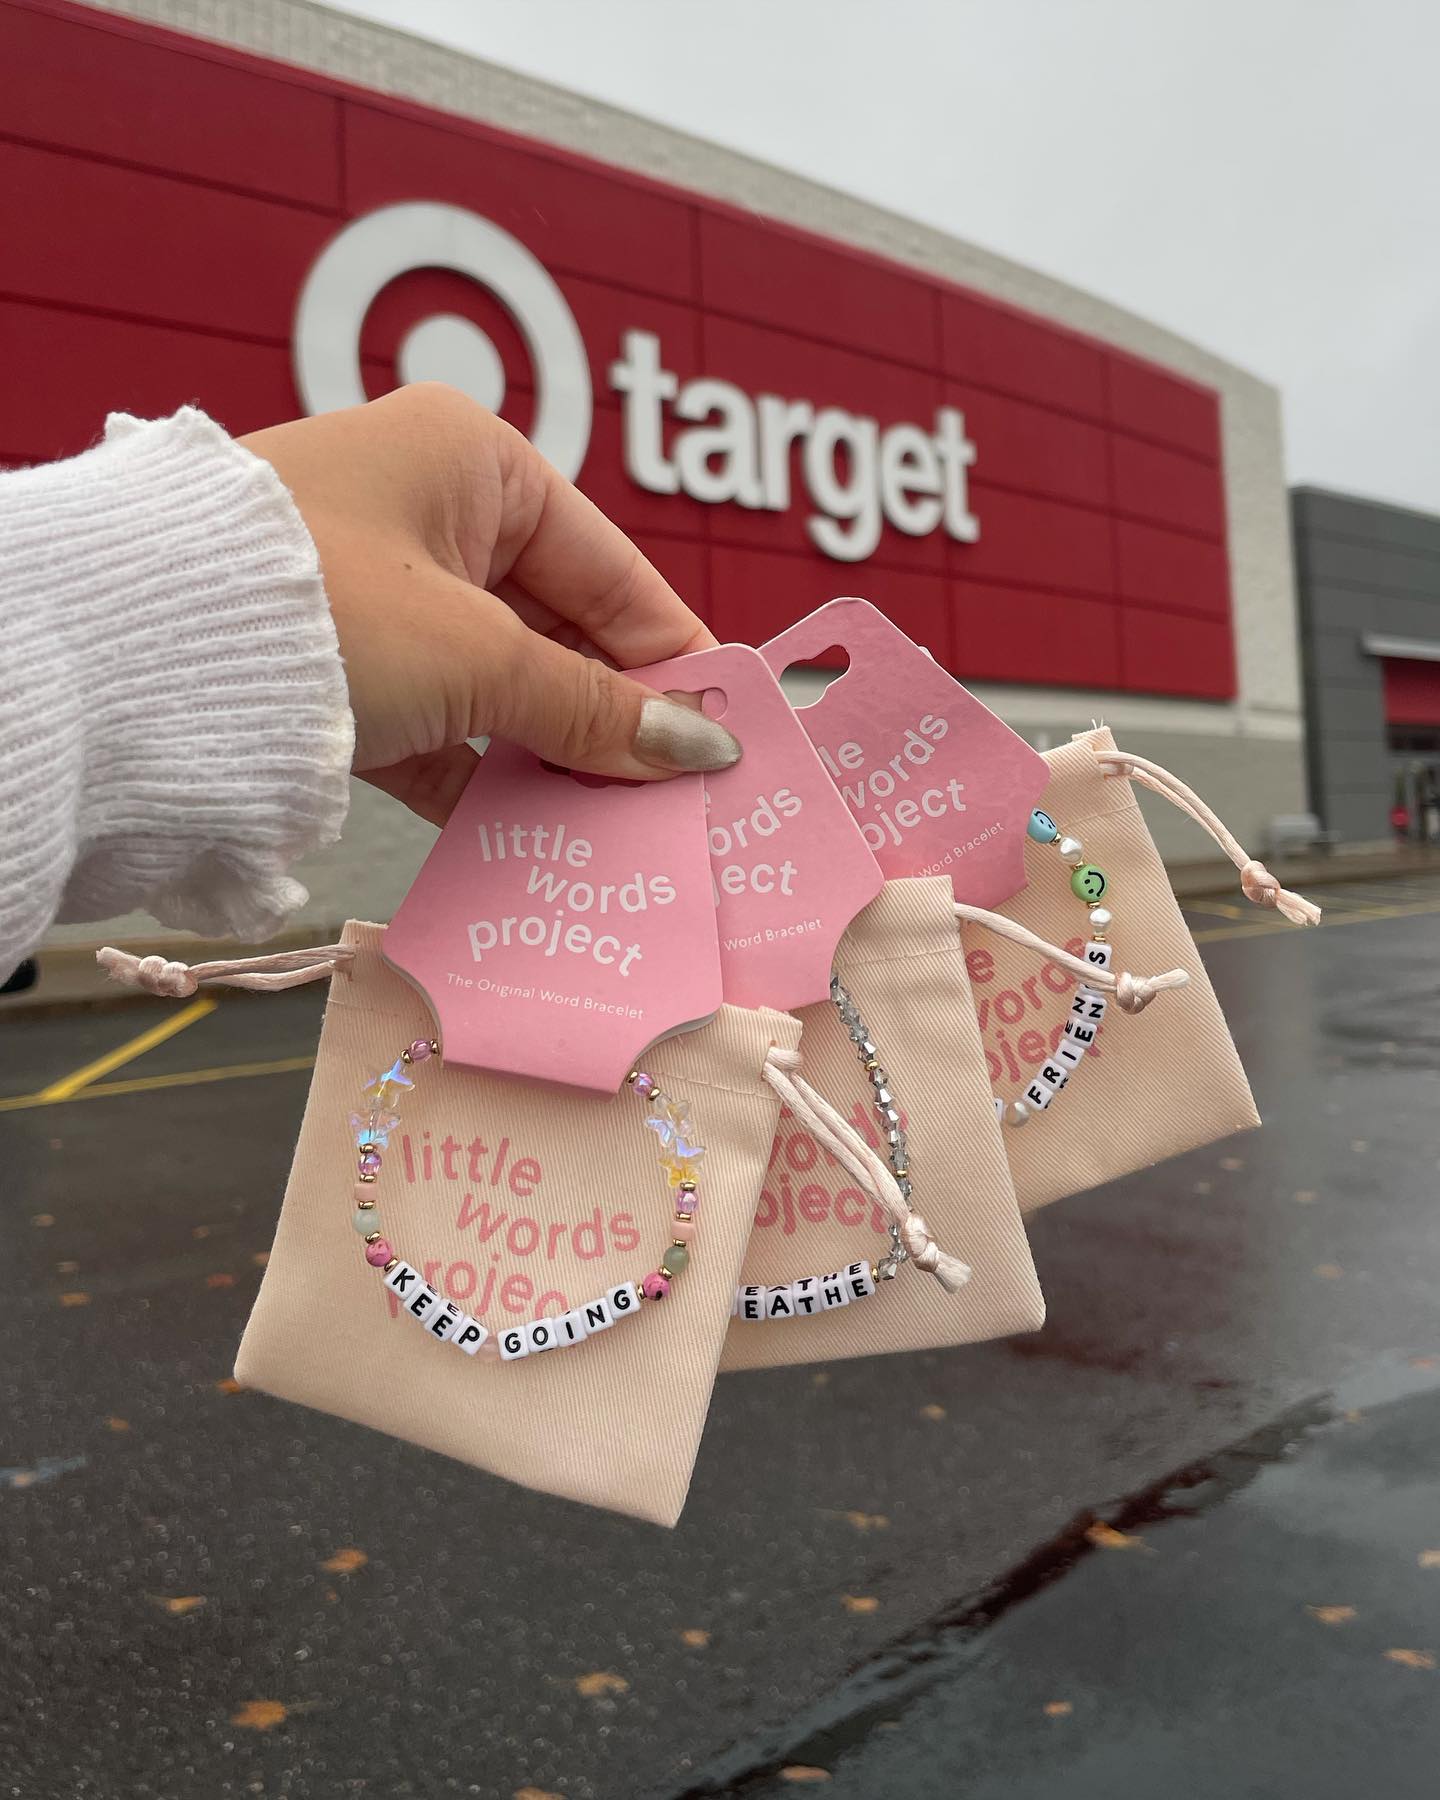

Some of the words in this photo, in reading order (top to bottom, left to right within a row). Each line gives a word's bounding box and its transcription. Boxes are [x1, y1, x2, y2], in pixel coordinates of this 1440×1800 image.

[609, 327, 982, 563] target
[478, 822, 593, 868] little
[704, 788, 803, 857] ords
[860, 778, 967, 851] oject
[953, 822, 1004, 858] Bracelet
[526, 865, 677, 914] words
[467, 909, 643, 977] project
[724, 932, 762, 951] Word
[765, 918, 824, 942] Bracelet
[447, 972, 474, 989] The
[477, 978, 536, 1000] Original
[539, 987, 580, 1009] Word
[583, 997, 644, 1021] Bracelet
[1027, 951, 1106, 1105] FRIENS
[402, 1131, 542, 1198] little
[456, 1192, 641, 1262] words
[393, 1267, 481, 1345] KEEP
[504, 1289, 631, 1354] GOING
[744, 1278, 868, 1319] EATHE
